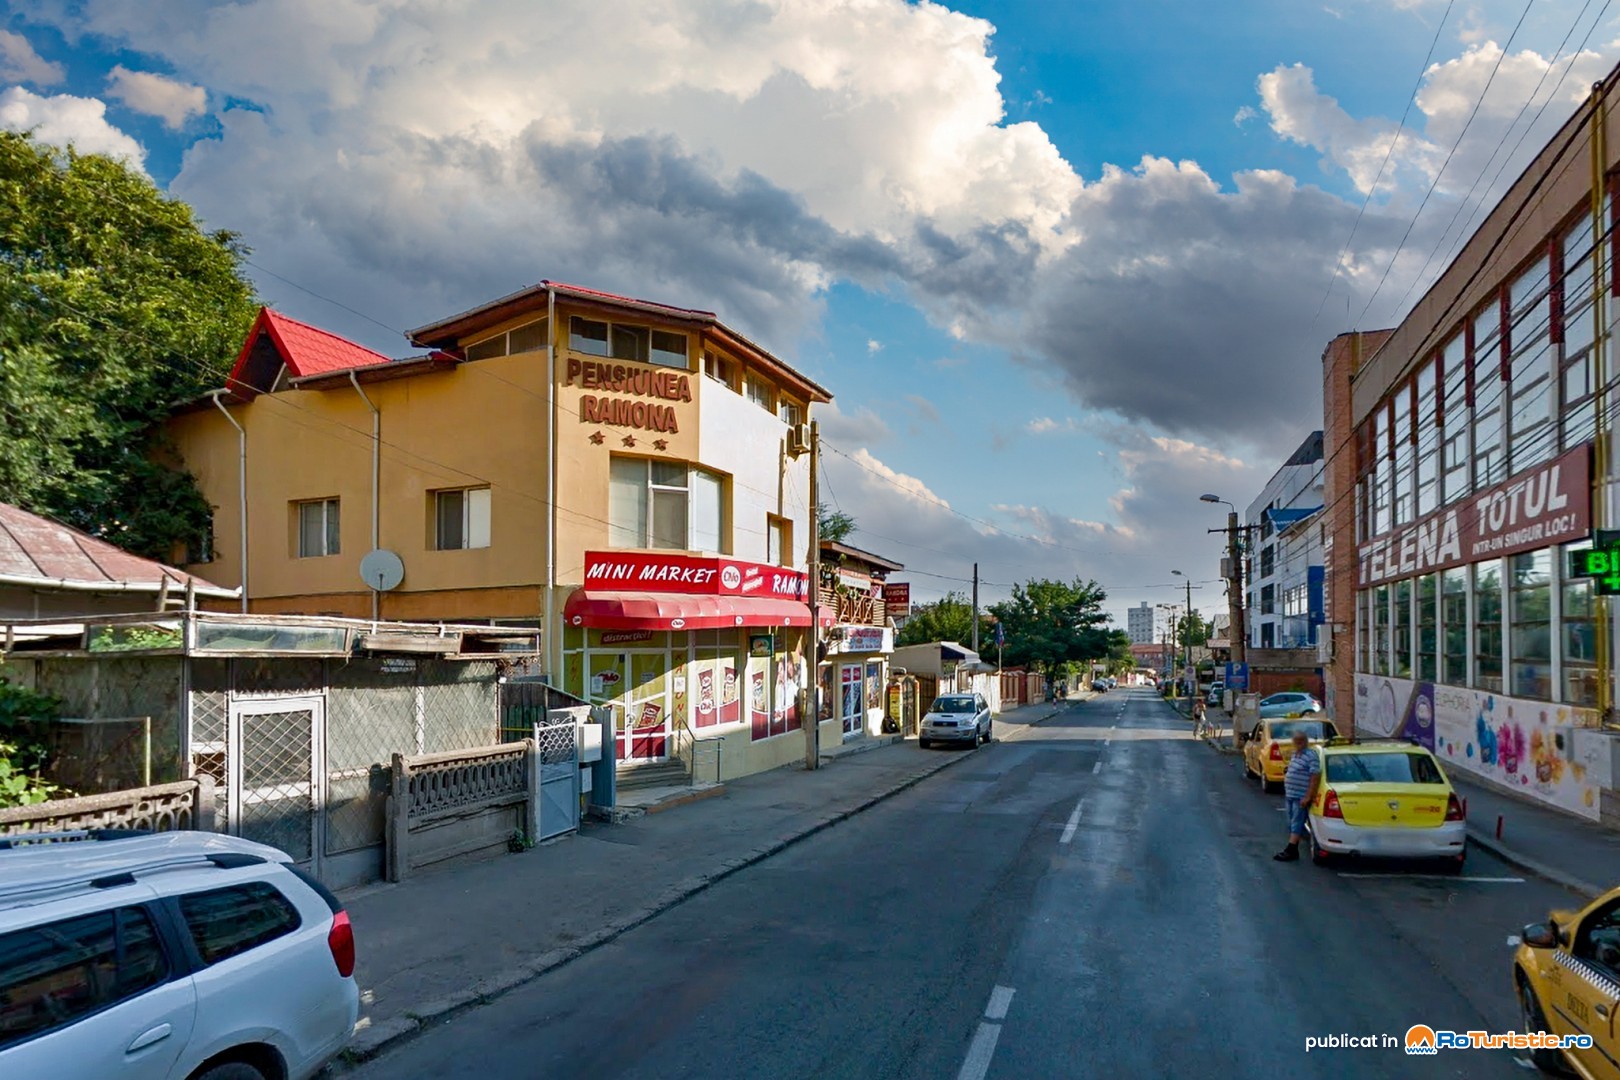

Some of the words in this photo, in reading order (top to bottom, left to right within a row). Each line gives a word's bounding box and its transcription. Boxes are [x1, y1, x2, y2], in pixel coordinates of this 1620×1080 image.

[567, 358, 692, 402] PENSIUNEA
[580, 395, 678, 434] RAMONA
[1477, 465, 1567, 536] TOTUL
[1359, 510, 1461, 584] TELENA
[587, 563, 635, 579] MINI
[639, 565, 717, 583] MARKET
[773, 574, 809, 595] RAMON
